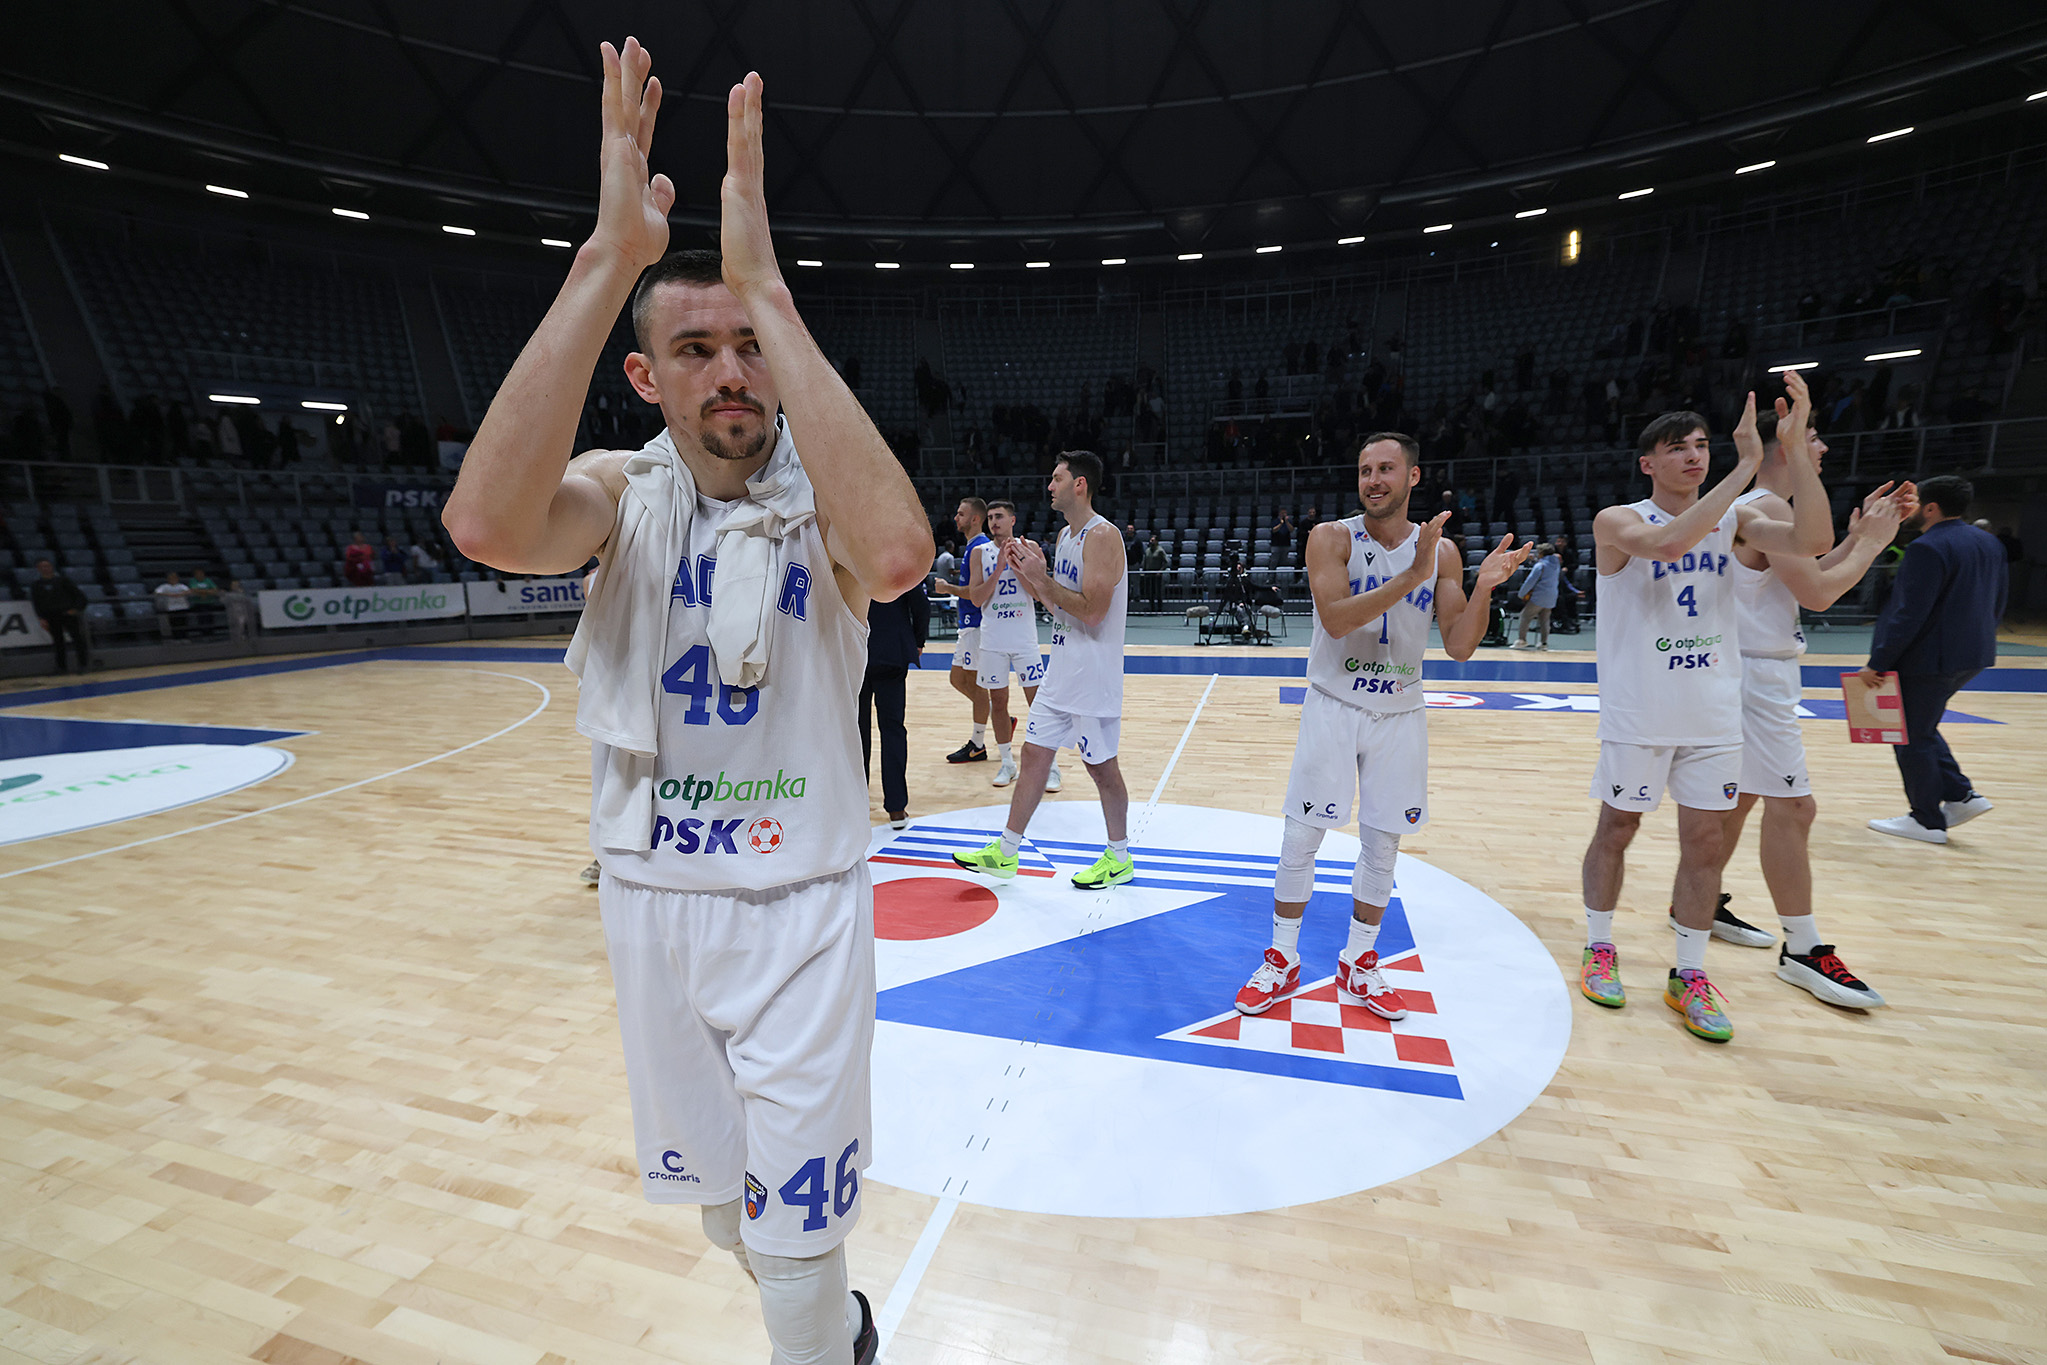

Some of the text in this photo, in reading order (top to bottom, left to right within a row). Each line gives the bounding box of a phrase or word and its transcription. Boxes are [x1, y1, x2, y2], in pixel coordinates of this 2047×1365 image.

[385, 489, 438, 508] PSK
[521, 582, 585, 603] sant
[999, 578, 1017, 595] 25
[324, 590, 446, 619] otpbanka
[1677, 585, 1698, 617] 4
[997, 610, 1015, 618] PSK
[1379, 612, 1388, 644] 1
[1052, 634, 1066, 646] SK
[964, 652, 971, 665] 6
[1669, 653, 1711, 670] PSK
[1026, 663, 1044, 681] 25
[1352, 678, 1395, 694] PSK
[659, 769, 806, 810] otpbanka
[651, 815, 745, 854] PSK
[648, 1171, 701, 1183] cromaris
[778, 1138, 859, 1232] 46
